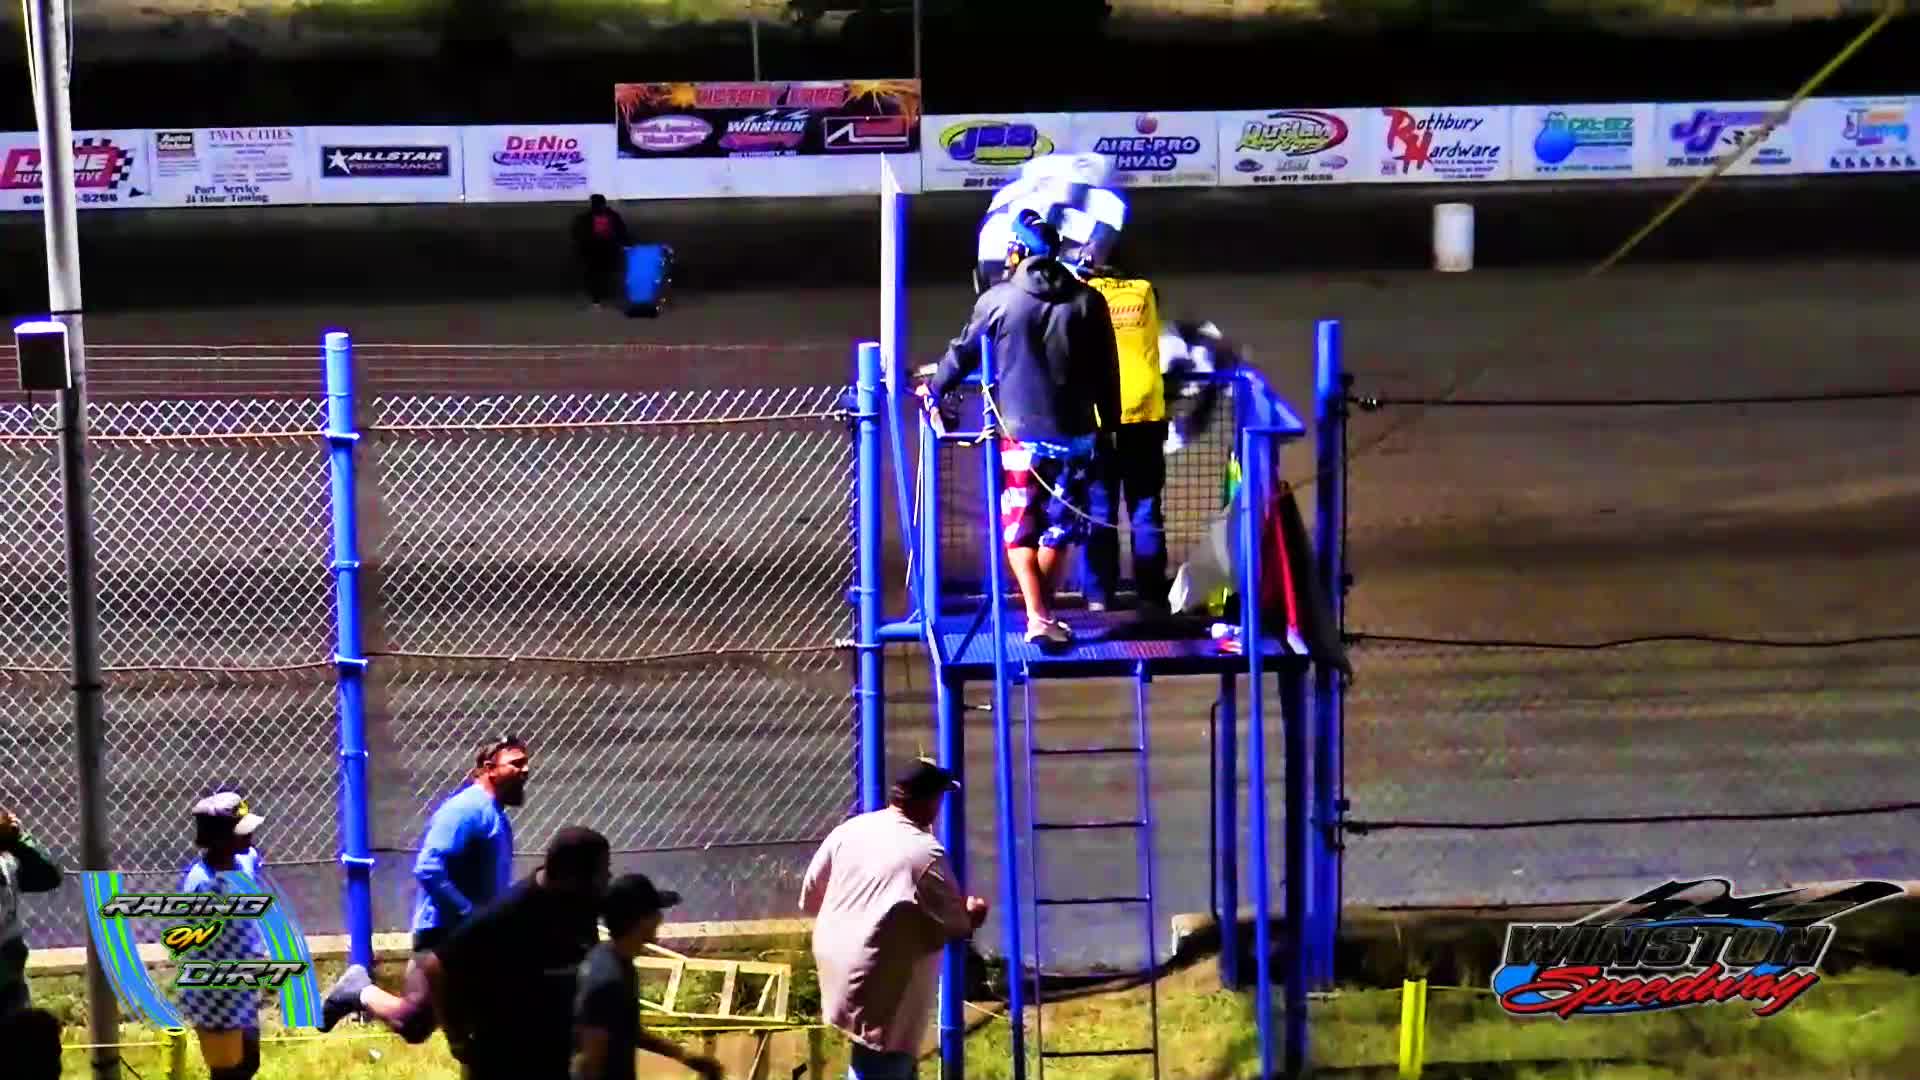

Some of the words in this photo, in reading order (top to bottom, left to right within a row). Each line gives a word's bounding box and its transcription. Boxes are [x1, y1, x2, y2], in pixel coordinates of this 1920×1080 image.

[727, 120, 805, 133] WINSTON
[1093, 136, 1201, 154] AIRE-PRO
[347, 151, 443, 161] ALLSTAR
[1116, 154, 1177, 171] HVAC
